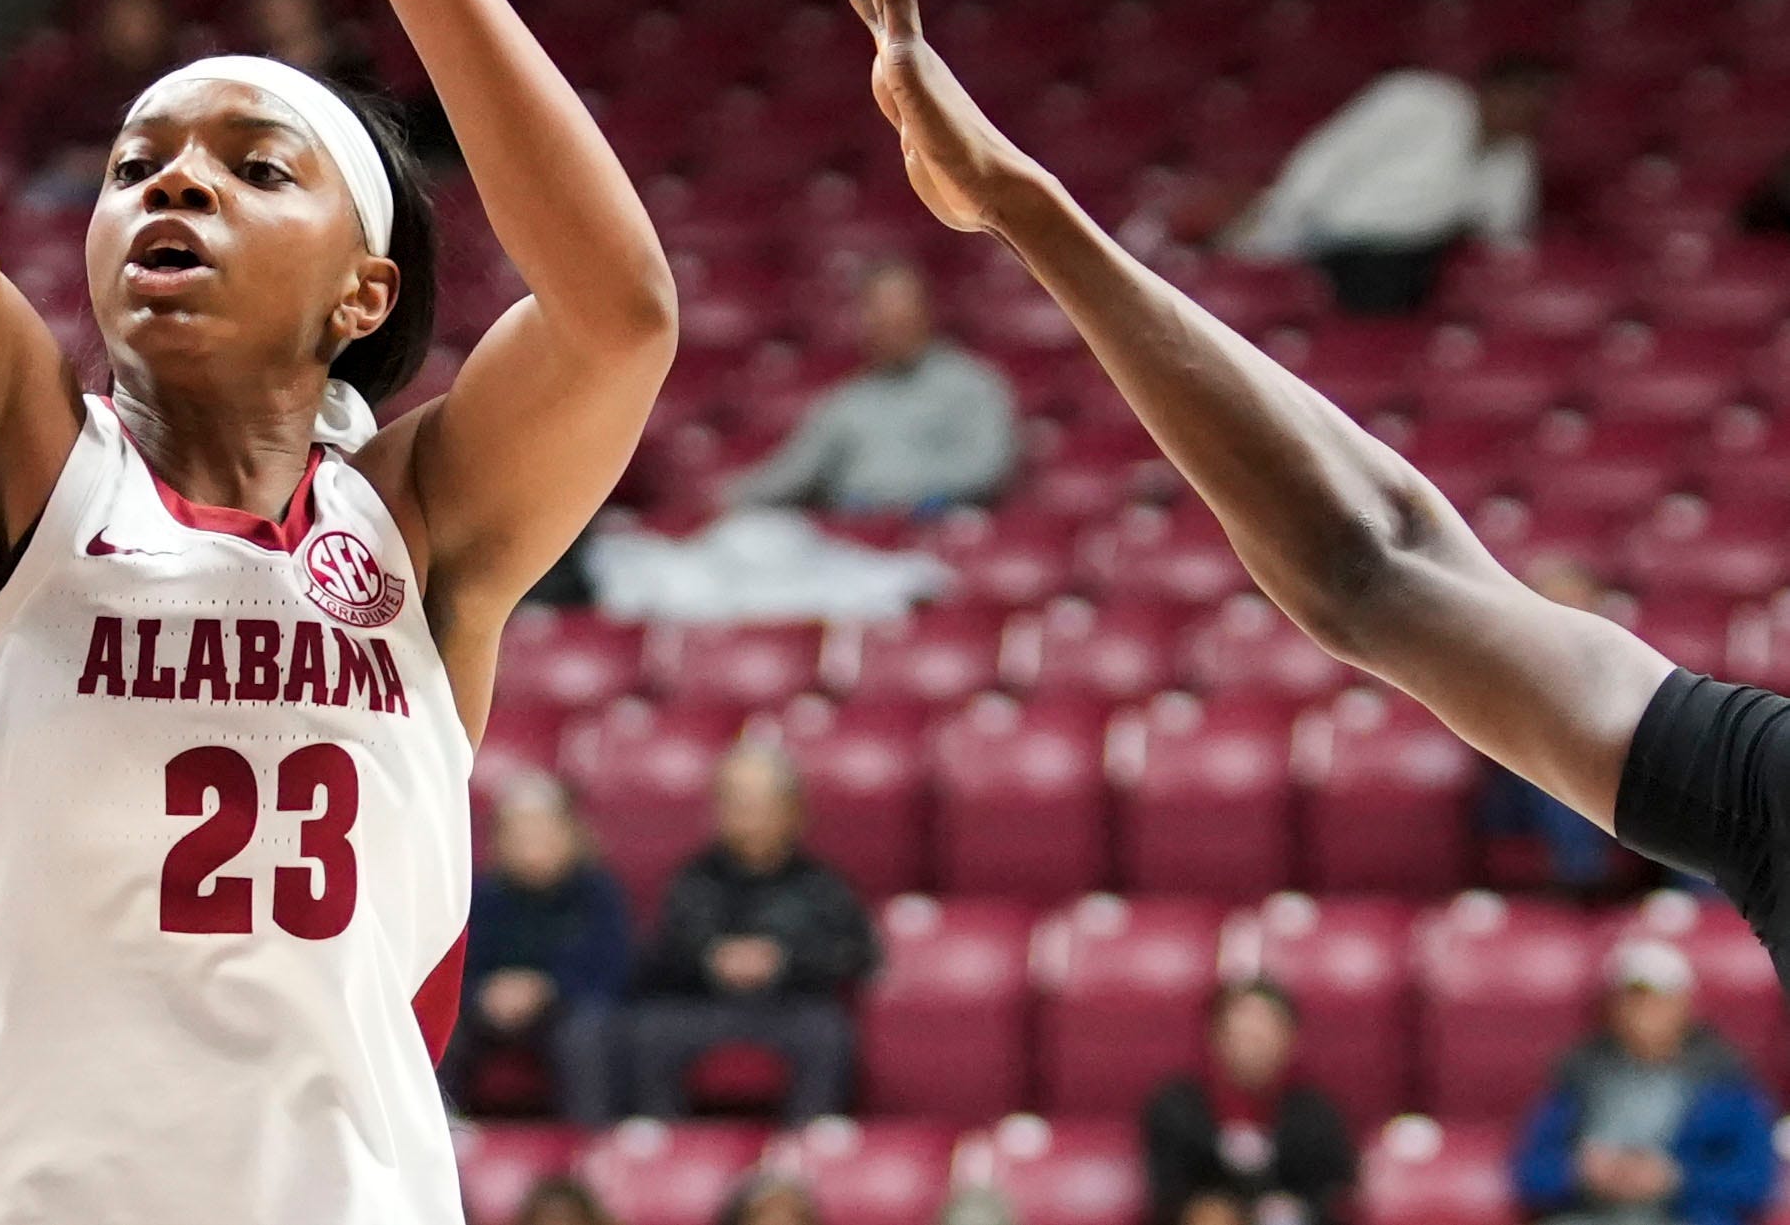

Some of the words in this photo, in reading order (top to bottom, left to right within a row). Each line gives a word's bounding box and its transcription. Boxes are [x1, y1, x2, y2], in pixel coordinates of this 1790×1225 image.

[311, 535, 379, 603] SEC
[326, 597, 400, 625] GRADUATE
[77, 616, 410, 718] ALABAMA
[160, 743, 359, 940] 23
